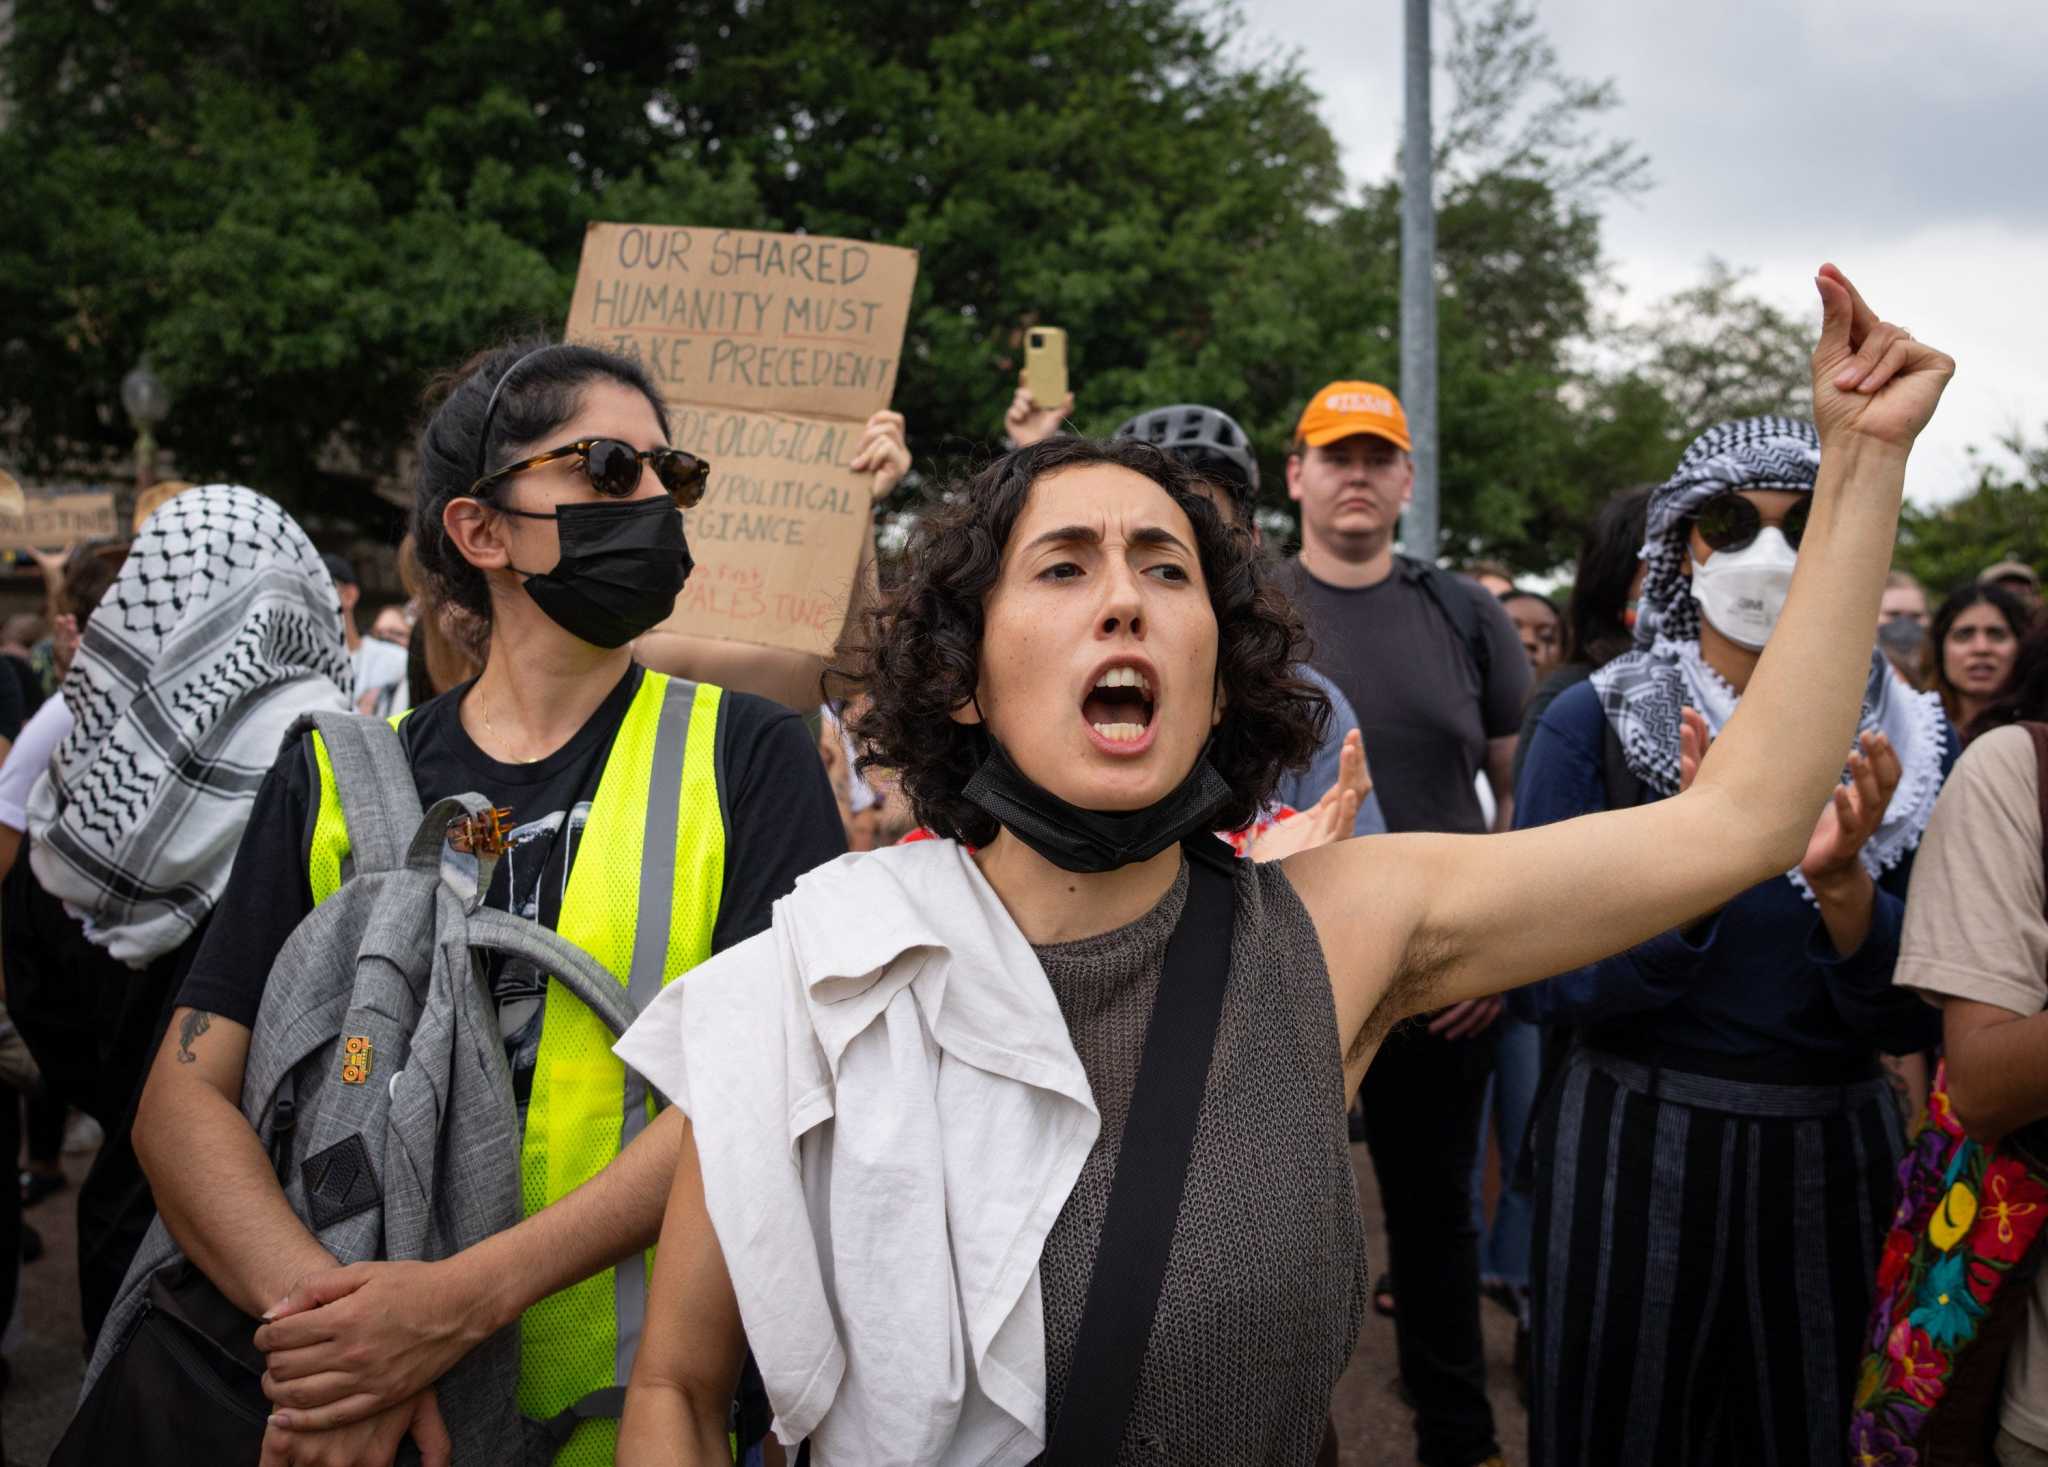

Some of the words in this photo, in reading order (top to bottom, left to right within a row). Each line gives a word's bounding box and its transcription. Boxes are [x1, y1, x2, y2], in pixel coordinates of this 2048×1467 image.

[618, 227, 692, 273] OUR
[709, 230, 870, 285] SHARED
[592, 280, 773, 334] HUMANITY
[783, 295, 881, 334] MUST
[708, 337, 892, 392] PRECEDENT
[704, 472, 854, 514] /POLITICAL
